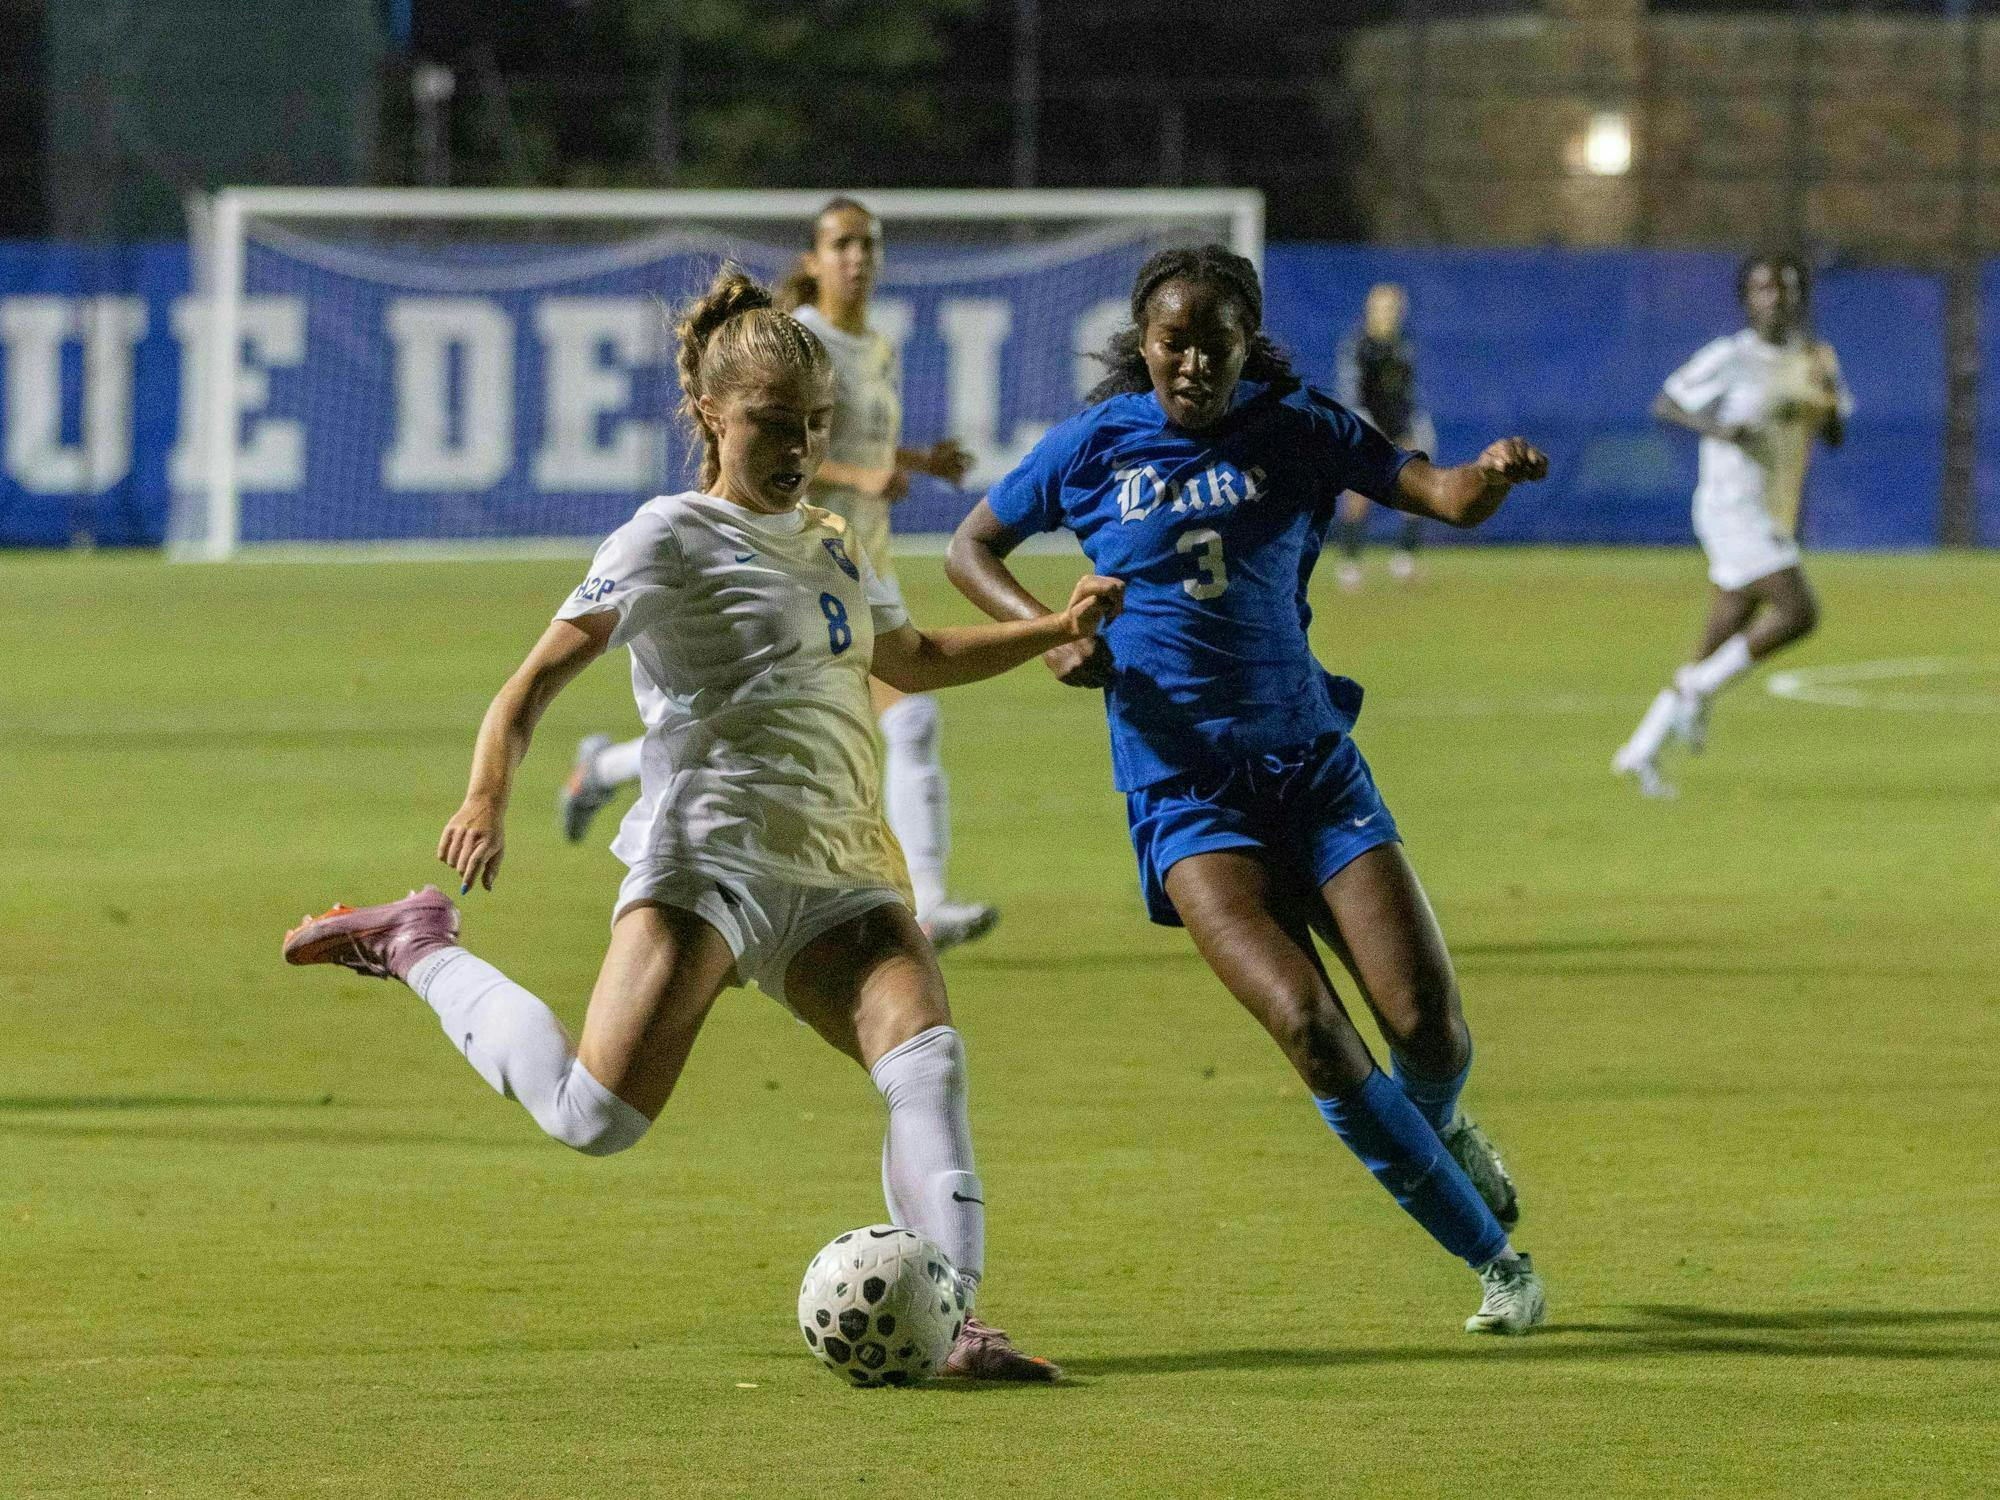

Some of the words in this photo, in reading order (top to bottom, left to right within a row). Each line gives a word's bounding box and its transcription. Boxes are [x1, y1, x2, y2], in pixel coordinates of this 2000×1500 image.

[382, 297, 1140, 493] DEL
[1114, 465, 1268, 525] Duke
[575, 577, 616, 602] H2P
[1176, 528, 1229, 600] 3
[819, 592, 852, 656] 8
